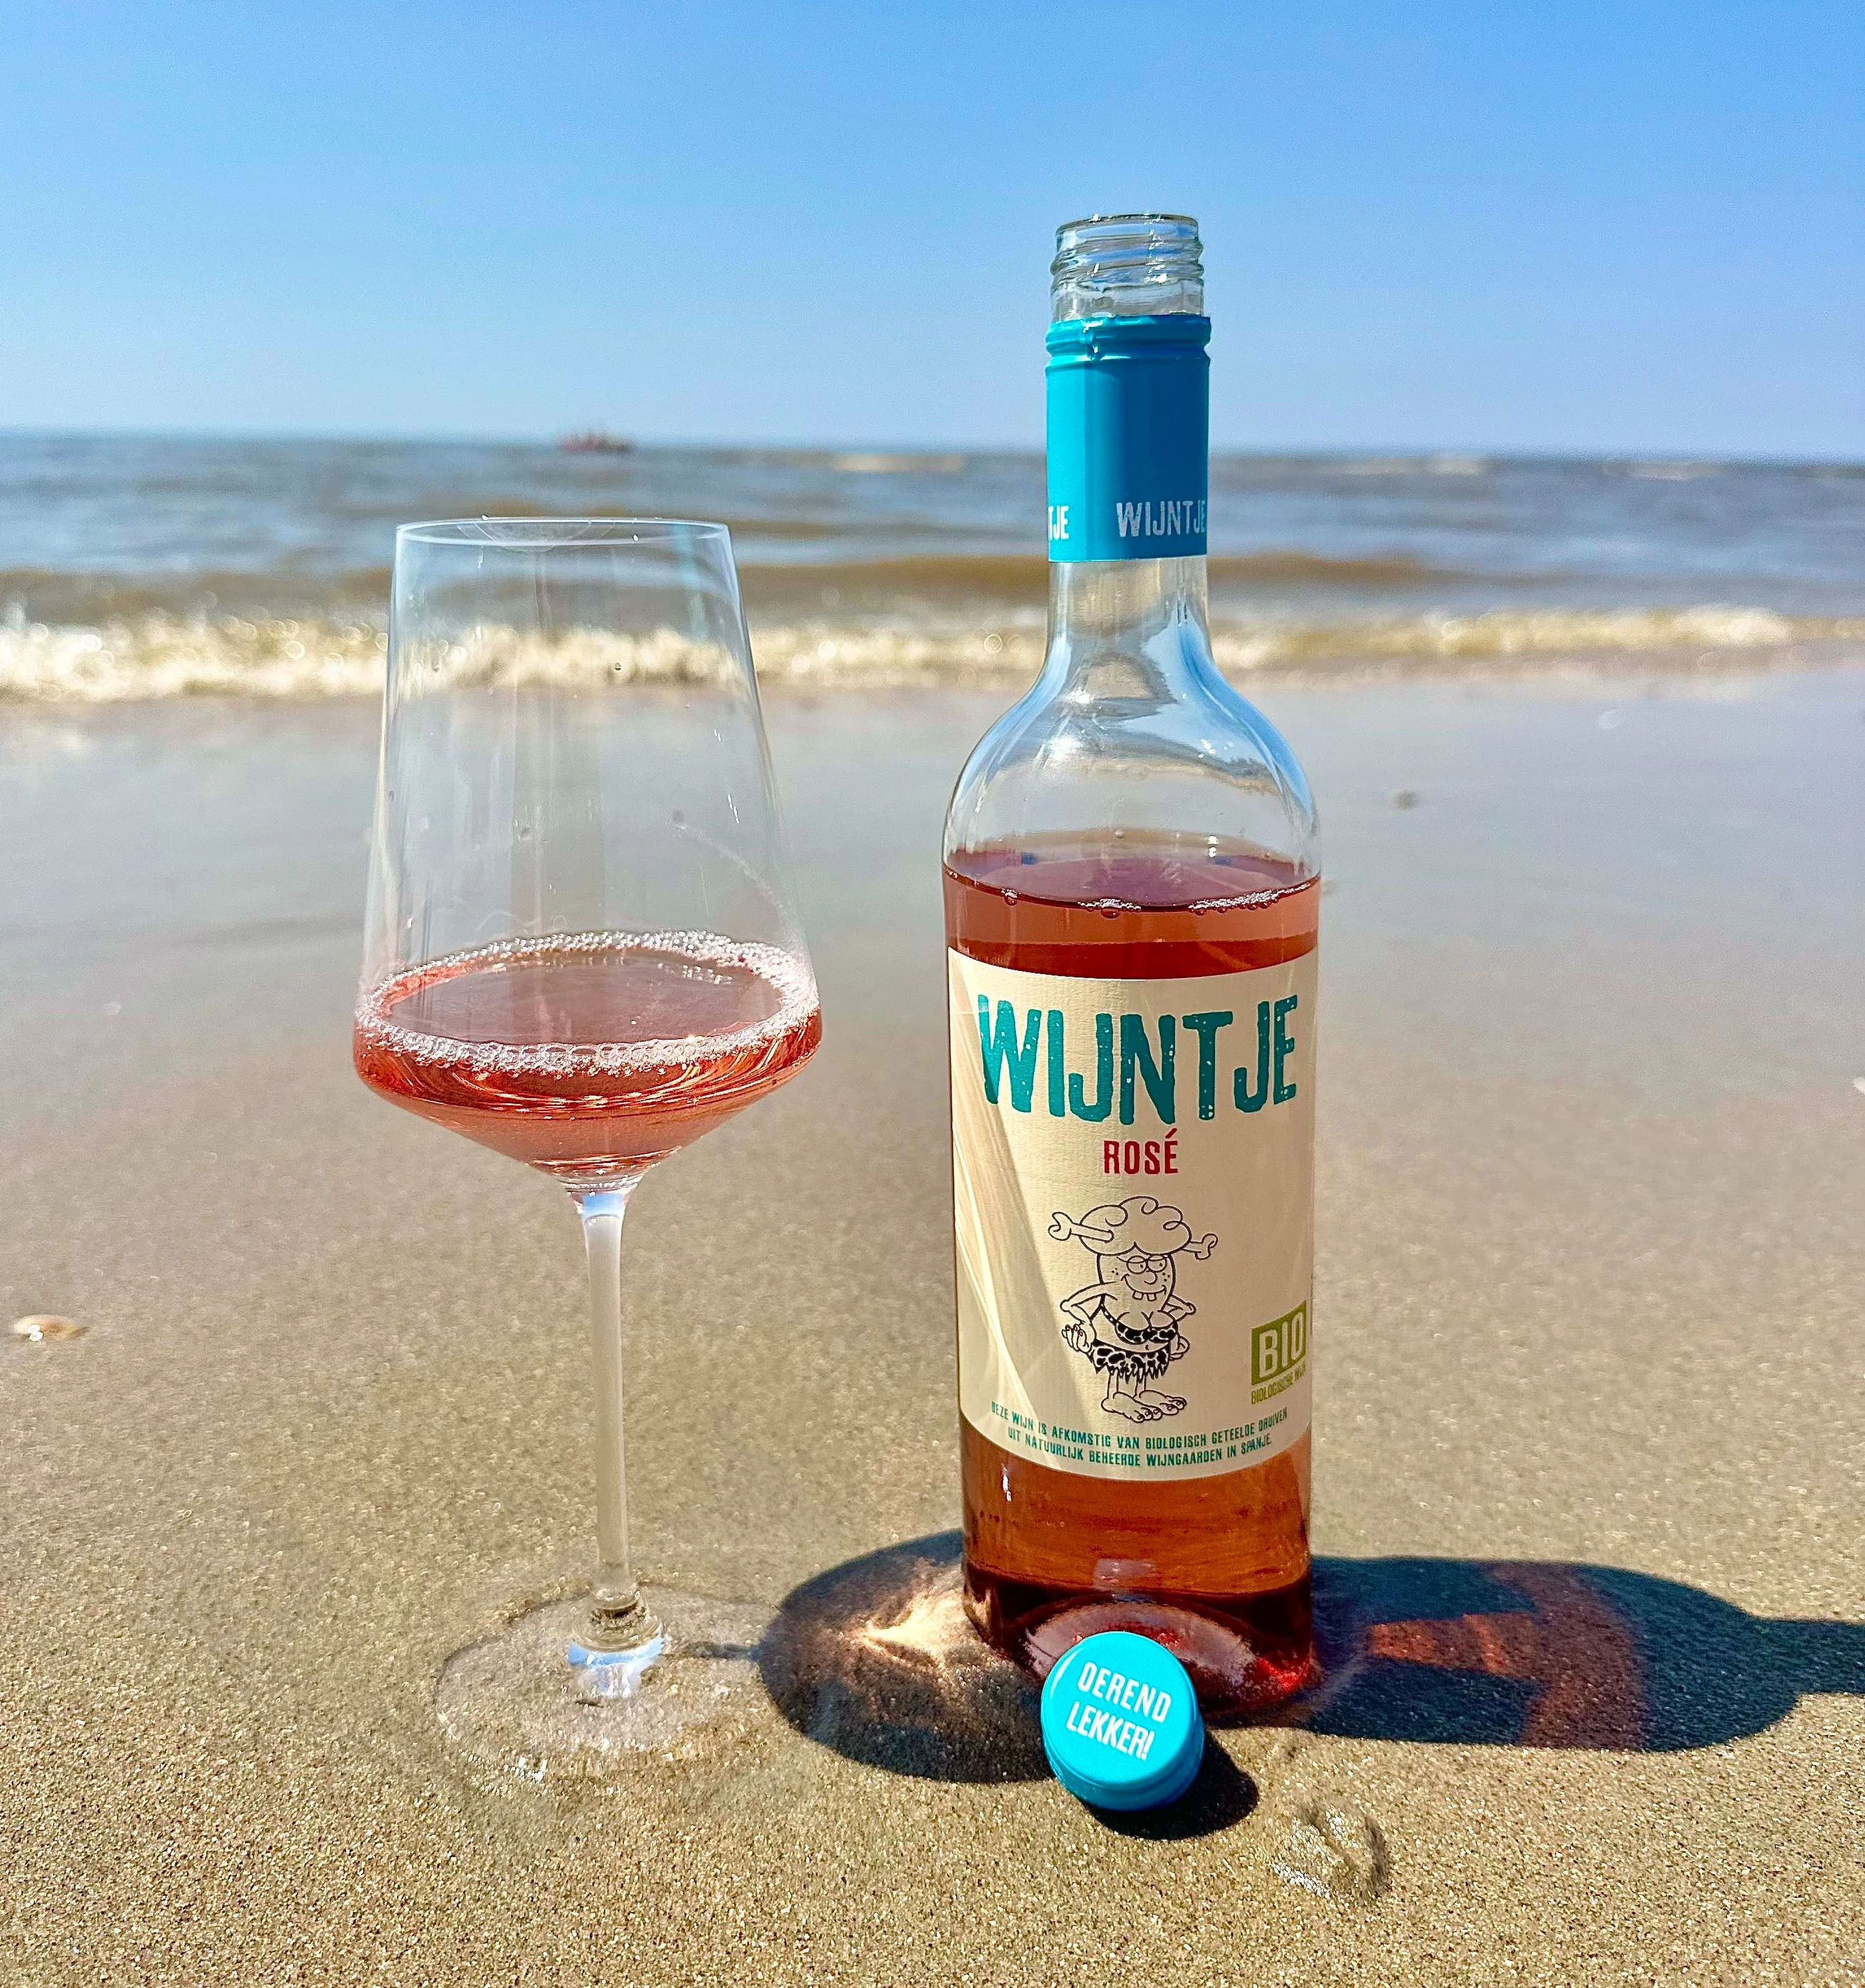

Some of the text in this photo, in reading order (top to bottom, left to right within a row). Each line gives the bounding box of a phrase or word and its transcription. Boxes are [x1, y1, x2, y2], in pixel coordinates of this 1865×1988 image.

[1116, 499, 1205, 538] WIJNTJE
[978, 994, 1297, 1125] WIJNTJE
[1103, 1128, 1178, 1175] ROSÉ
[1259, 1311, 1303, 1378] BIO
[991, 1401, 1288, 1450] DEZE WIJN IS AFKOMSTIG VAN BIOLOGISCH GETEELDE DRUIVEN
[1008, 1426, 1020, 1442] UIT
[1025, 1432, 1083, 1460] NATUURLIJK
[1089, 1452, 1140, 1466] BEHEERDE
[1146, 1448, 1222, 1467] WIJNGAARDEN
[1227, 1444, 1236, 1458] IN
[1077, 1661, 1172, 1723] OEREND
[1066, 1701, 1155, 1762] LEKKER!
